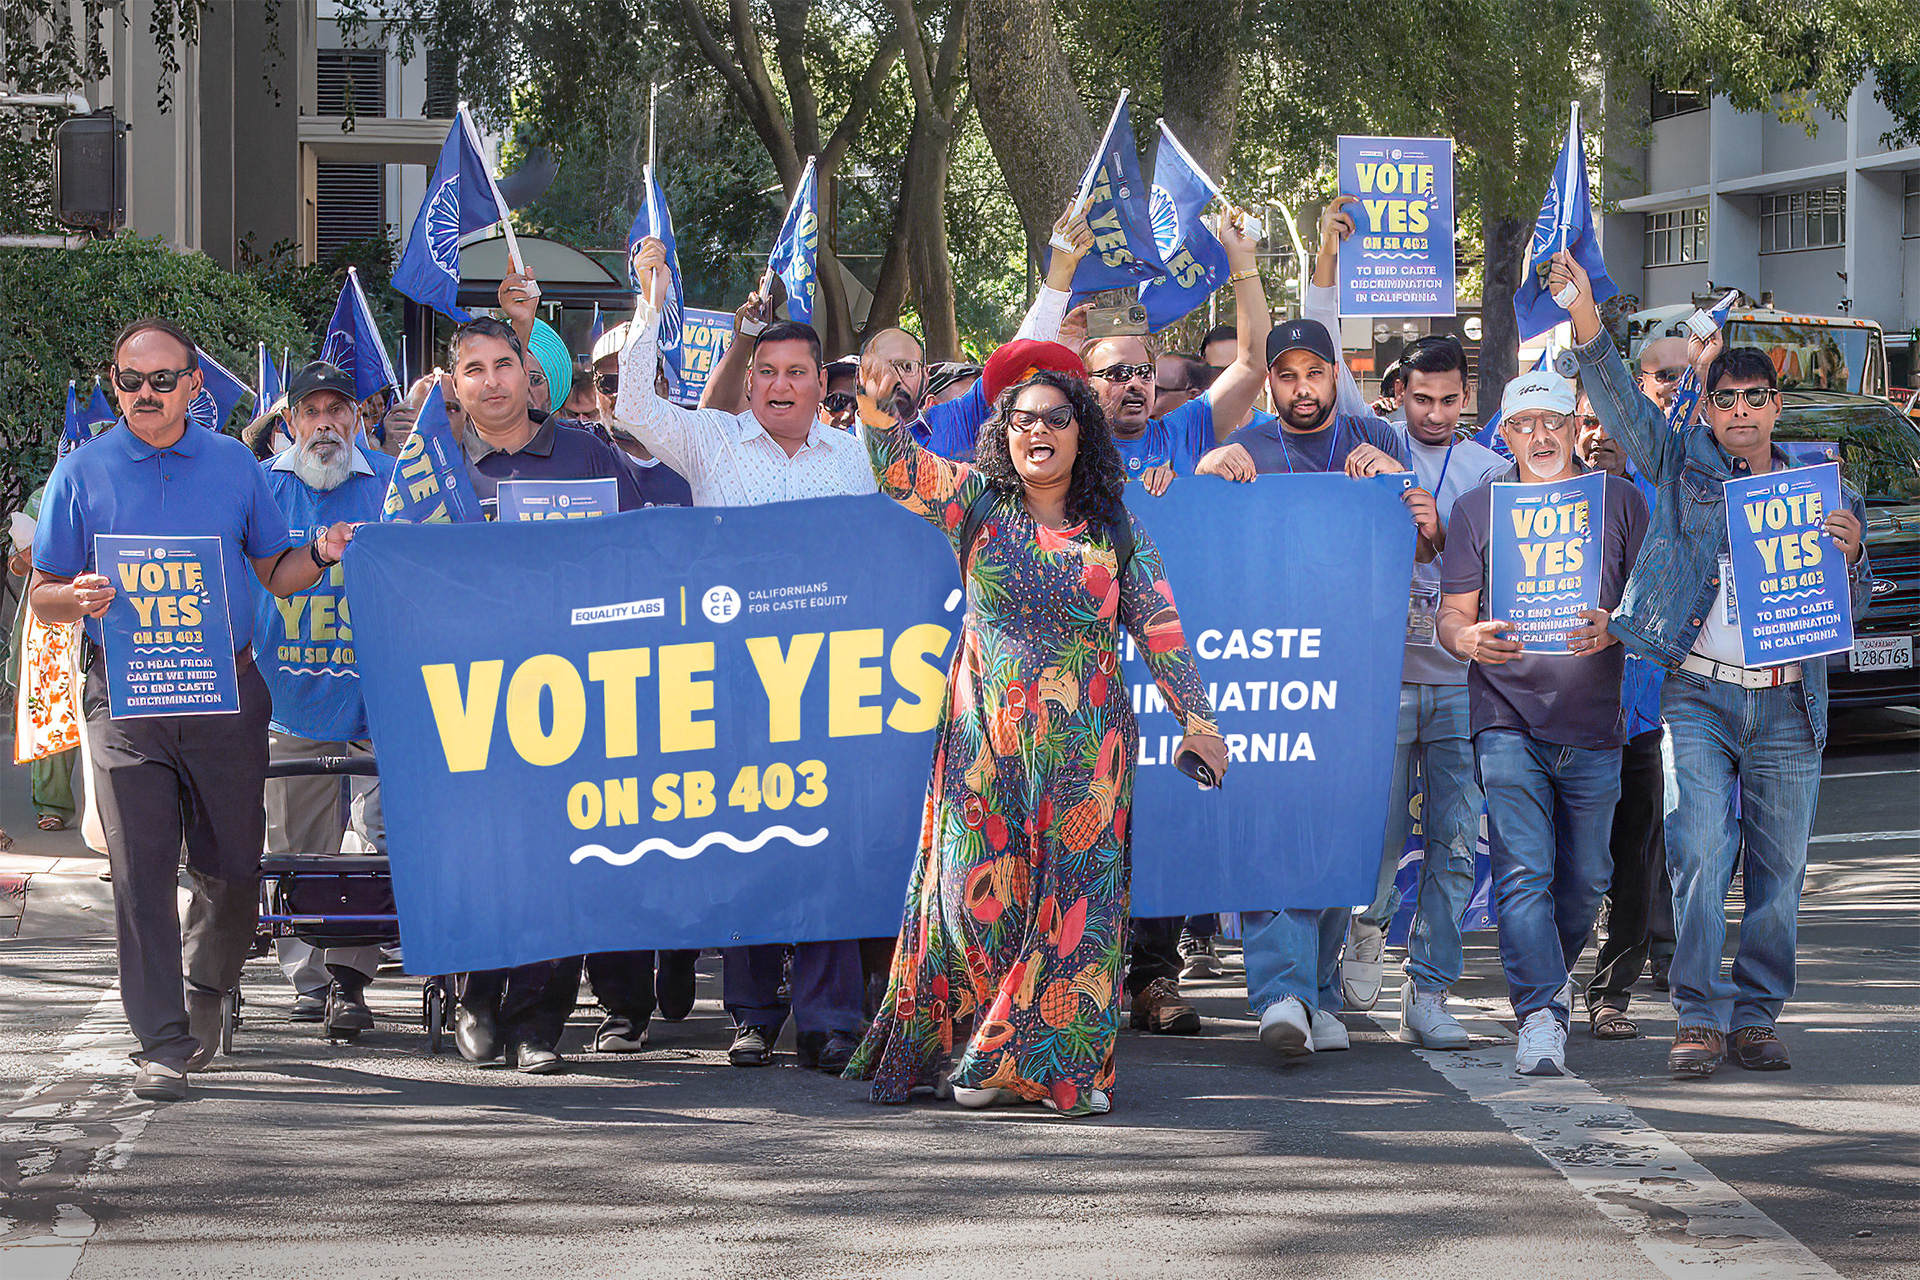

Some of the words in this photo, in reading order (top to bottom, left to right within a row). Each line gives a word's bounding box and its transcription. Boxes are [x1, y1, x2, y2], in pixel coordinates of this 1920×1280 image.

[1355, 163, 1434, 195] VOTE
[1362, 199, 1430, 234] YES
[1090, 207, 1135, 267] YES
[1363, 237, 1381, 250] ON
[1383, 237, 1401, 250] SB
[1403, 237, 1429, 250] 403
[1165, 246, 1206, 288] ES
[1356, 266, 1372, 276] TO
[1374, 265, 1398, 276] END
[1401, 265, 1437, 276] CASTE
[1350, 279, 1443, 289] DISCRIMINATION
[1356, 292, 1368, 302] IN
[1370, 293, 1438, 303] CALIFORNIA
[683, 347, 712, 372] YE
[398, 432, 440, 504] OTE
[1511, 500, 1589, 539] VOTE
[1743, 491, 1823, 534] VOTE
[1518, 537, 1584, 577] YES
[1754, 530, 1823, 574] YES
[117, 562, 204, 593] VOTE
[1516, 580, 1536, 594] ON
[1538, 579, 1556, 593] SB
[1557, 576, 1583, 591] 403
[1759, 578, 1779, 594] ON
[1780, 575, 1798, 591] SB
[1799, 571, 1825, 588] 403
[748, 582, 829, 600] CALIFORNIANS
[129, 595, 203, 628] YES
[575, 606, 628, 622] EQUALITY
[631, 602, 661, 616] LABS
[748, 602, 770, 614] FOR
[772, 599, 808, 612] CASTE
[810, 595, 848, 609] EQUITY
[1509, 609, 1525, 619] TO
[1527, 608, 1552, 618] END
[1756, 610, 1773, 622] TO
[1775, 606, 1798, 619] END
[1800, 601, 1835, 615] CASTE
[1752, 613, 1842, 638] DISCRIMINATION
[132, 632, 153, 645] ON
[155, 632, 173, 644] SB
[175, 631, 203, 643] 403
[1196, 628, 1322, 660] CASTE
[1759, 638, 1773, 651] IN
[1774, 629, 1839, 648] CALIFORNIA
[128, 661, 144, 670] TO
[147, 659, 177, 669] HEAL
[180, 658, 213, 668] FROM
[278, 646, 301, 663] ON
[331, 647, 358, 664] 40
[1853, 648, 1909, 667] 1286765
[126, 672, 163, 682] CASTE
[166, 672, 184, 681] WE
[187, 670, 217, 680] NEED
[132, 685, 147, 694] TO
[151, 684, 175, 693] END
[177, 682, 215, 692] CASTE
[420, 642, 716, 773] VOTE
[745, 622, 953, 744] YES
[126, 693, 222, 707] DISCRIMINATION
[566, 777, 639, 831] ON
[651, 769, 717, 822] SB
[728, 759, 829, 813] 403
